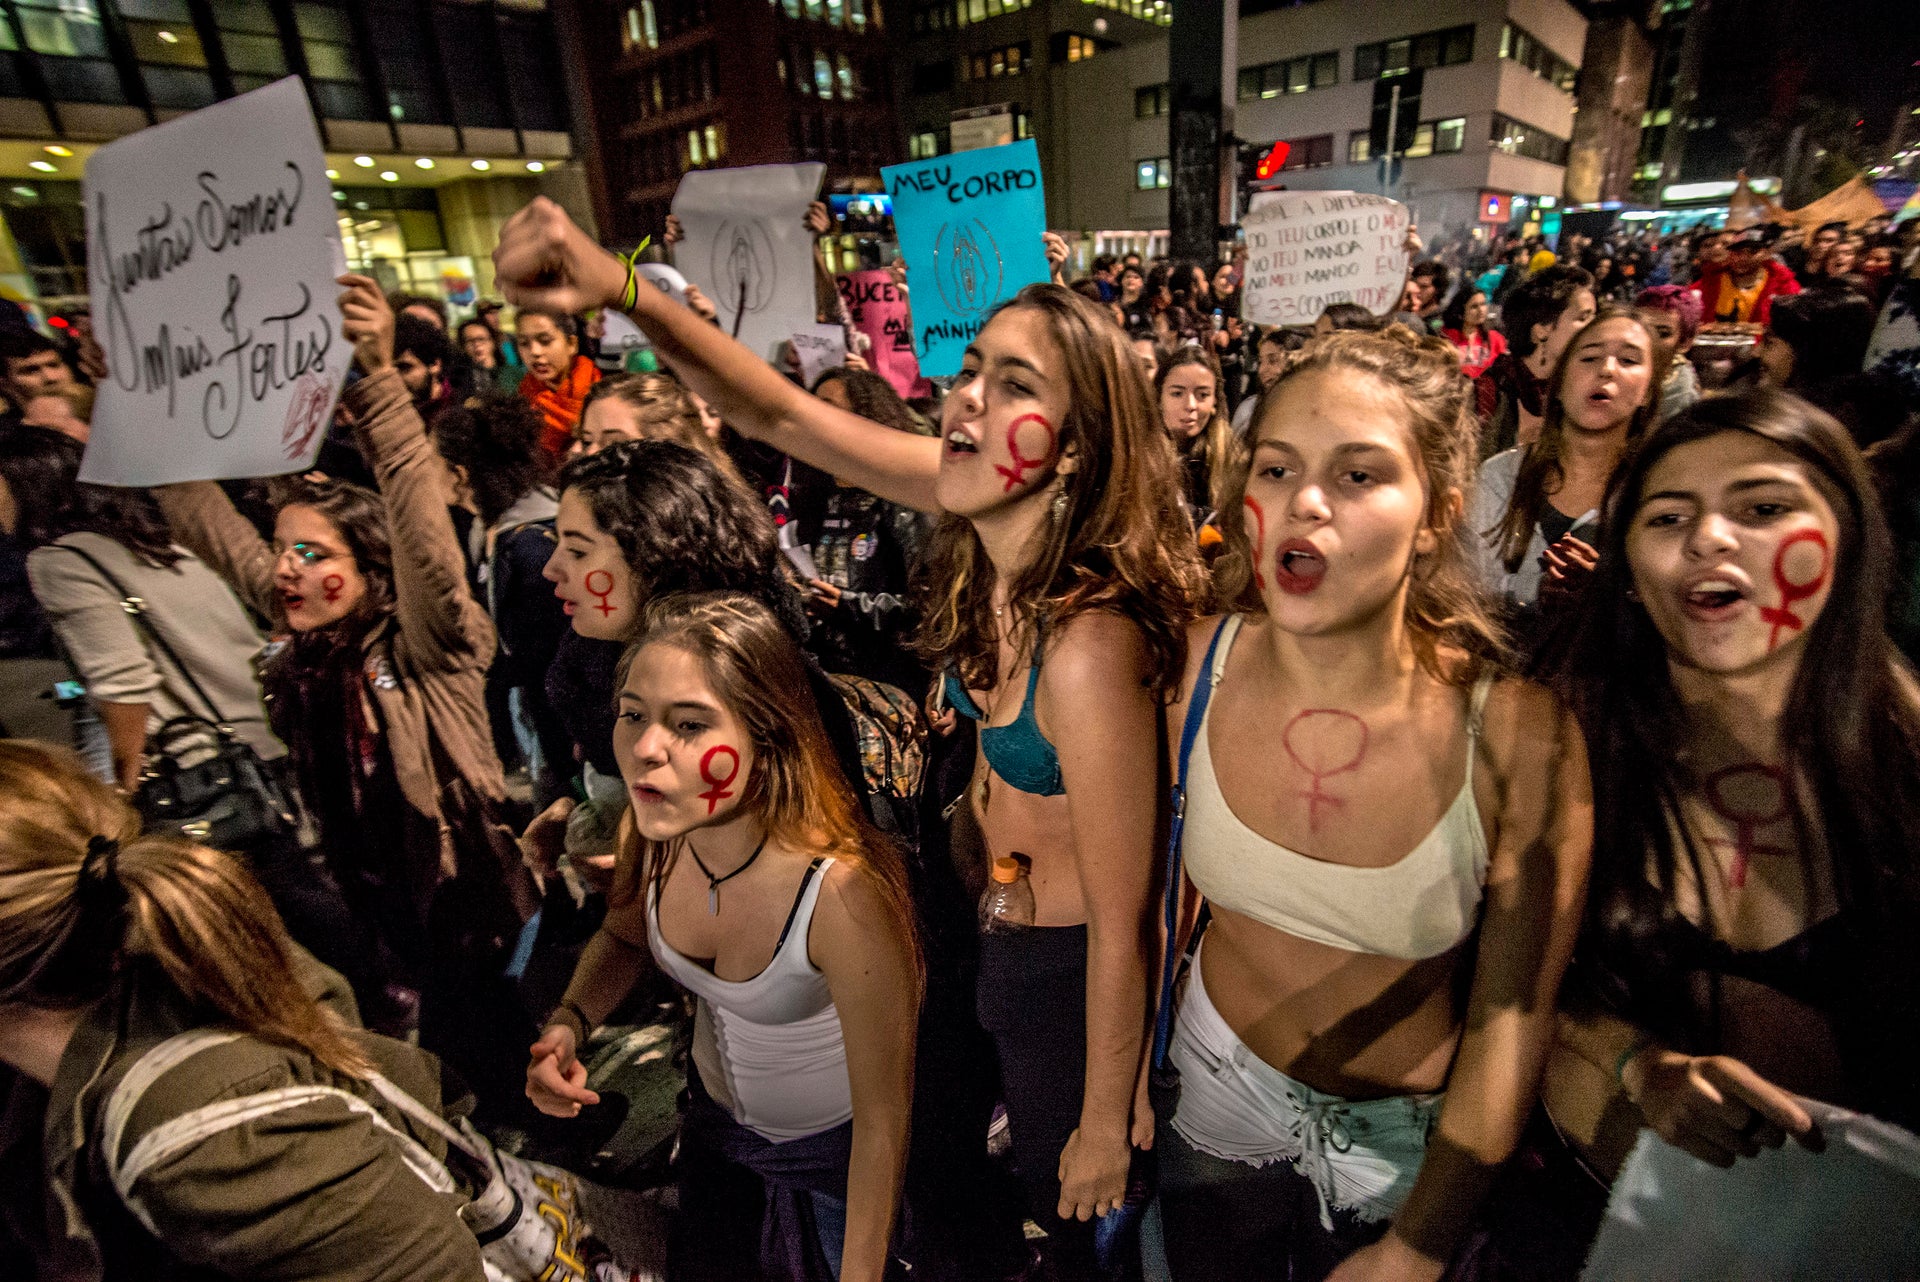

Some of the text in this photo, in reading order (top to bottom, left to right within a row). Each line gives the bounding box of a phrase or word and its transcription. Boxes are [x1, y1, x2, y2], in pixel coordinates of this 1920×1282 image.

[892, 165, 1036, 203] MEU CORPO
[197, 161, 302, 252] Somos
[1277, 226, 1304, 246] TEU
[1367, 214, 1380, 232] O
[1273, 249, 1298, 269] TEU
[1304, 239, 1364, 262] MANDA
[1247, 276, 1267, 292] NO
[1304, 262, 1360, 284] MANDO
